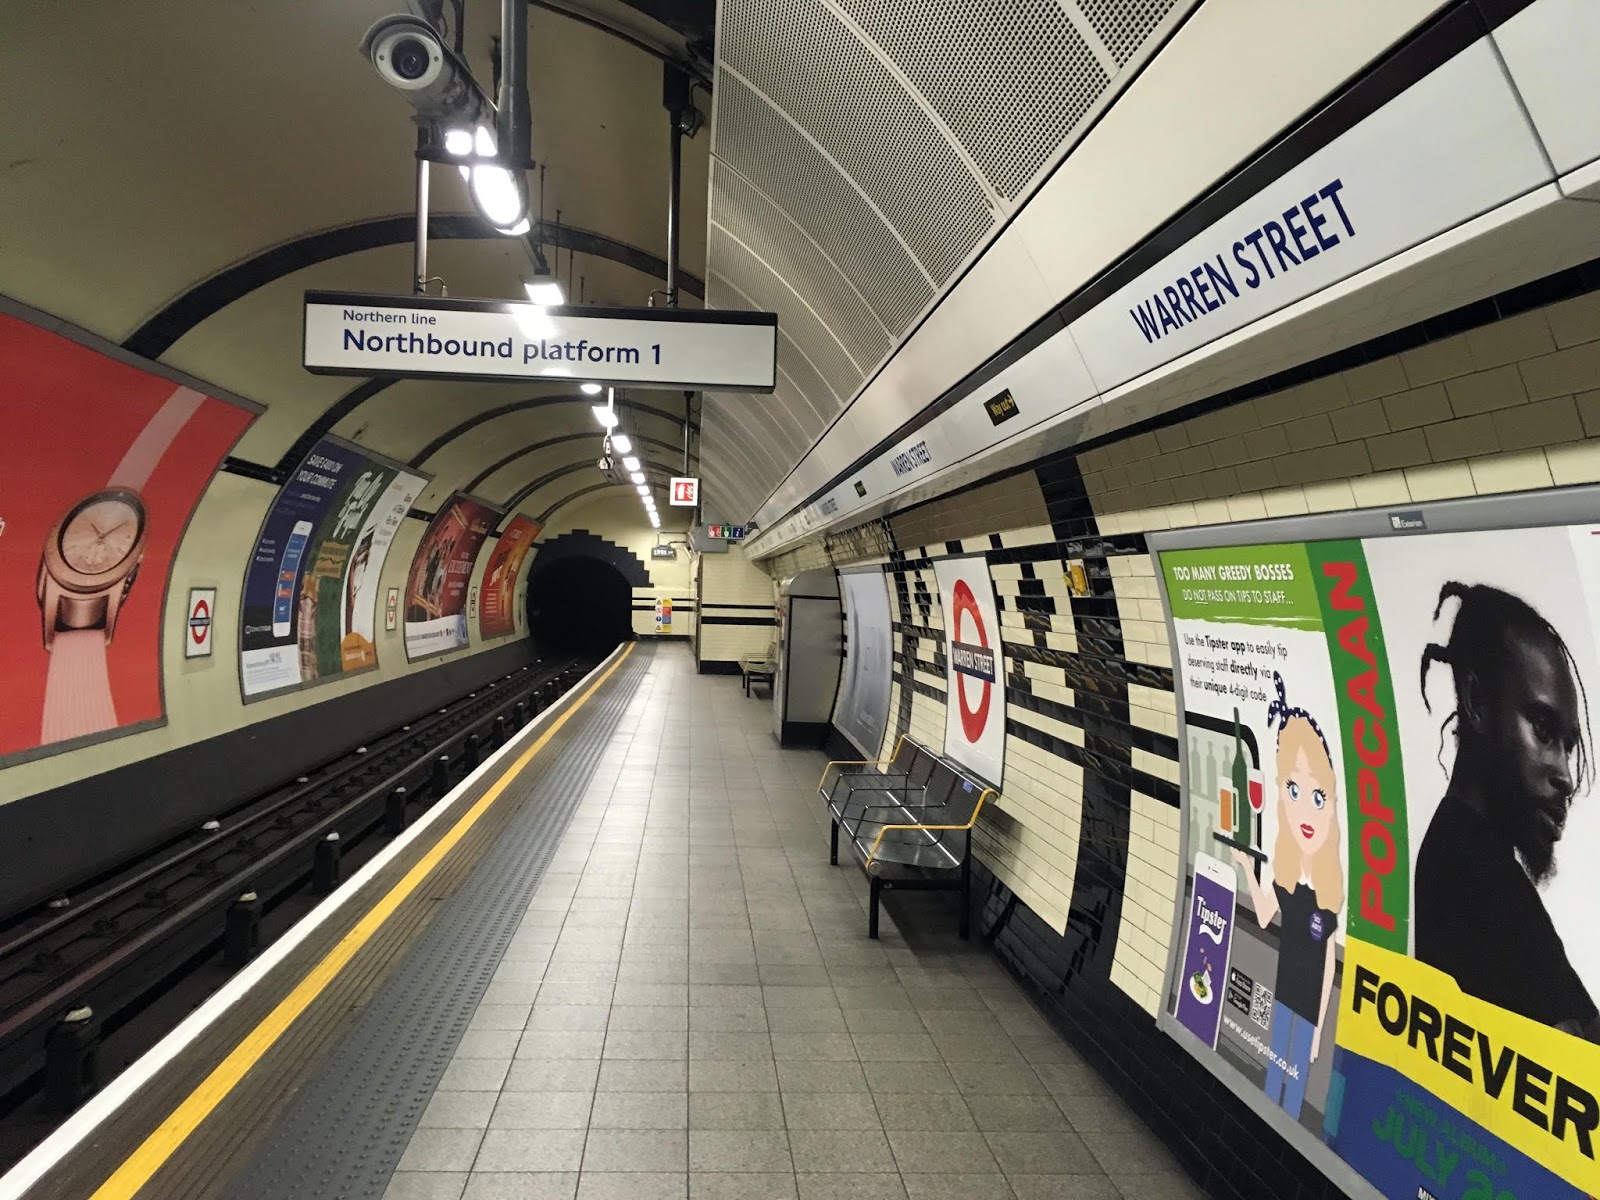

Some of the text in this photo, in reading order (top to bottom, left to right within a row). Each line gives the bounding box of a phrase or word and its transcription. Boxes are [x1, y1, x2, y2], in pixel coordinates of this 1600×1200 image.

[1129, 178, 1356, 344] WARREN STREET
[343, 309, 437, 325] Northern line
[343, 328, 661, 365] Northbound platform 1
[890, 440, 932, 477] WARREN STREET
[1173, 563, 1294, 581] TOO MANY GREEDY BOSSES
[1182, 589, 1193, 600] DO
[1193, 589, 1207, 602] NOT
[1207, 590, 1224, 602] PASS
[1223, 590, 1237, 602] ON
[1237, 590, 1252, 603] TIPS
[1252, 590, 1263, 603] TO
[952, 647, 993, 676] WARREN STREET
[1183, 632, 1288, 661] Use the Tipster app to easily tip
[1187, 653, 1271, 680] deserving staff directly via
[1190, 675, 1267, 702] their unique 4-digit code
[1322, 561, 1397, 932] POPCAAN
[1197, 895, 1227, 930] Tipster
[1223, 1014, 1300, 1080] www.usetipster.co.uk
[1352, 964, 1600, 1162] FOREVER
[1371, 1106, 1462, 1191] JULY
